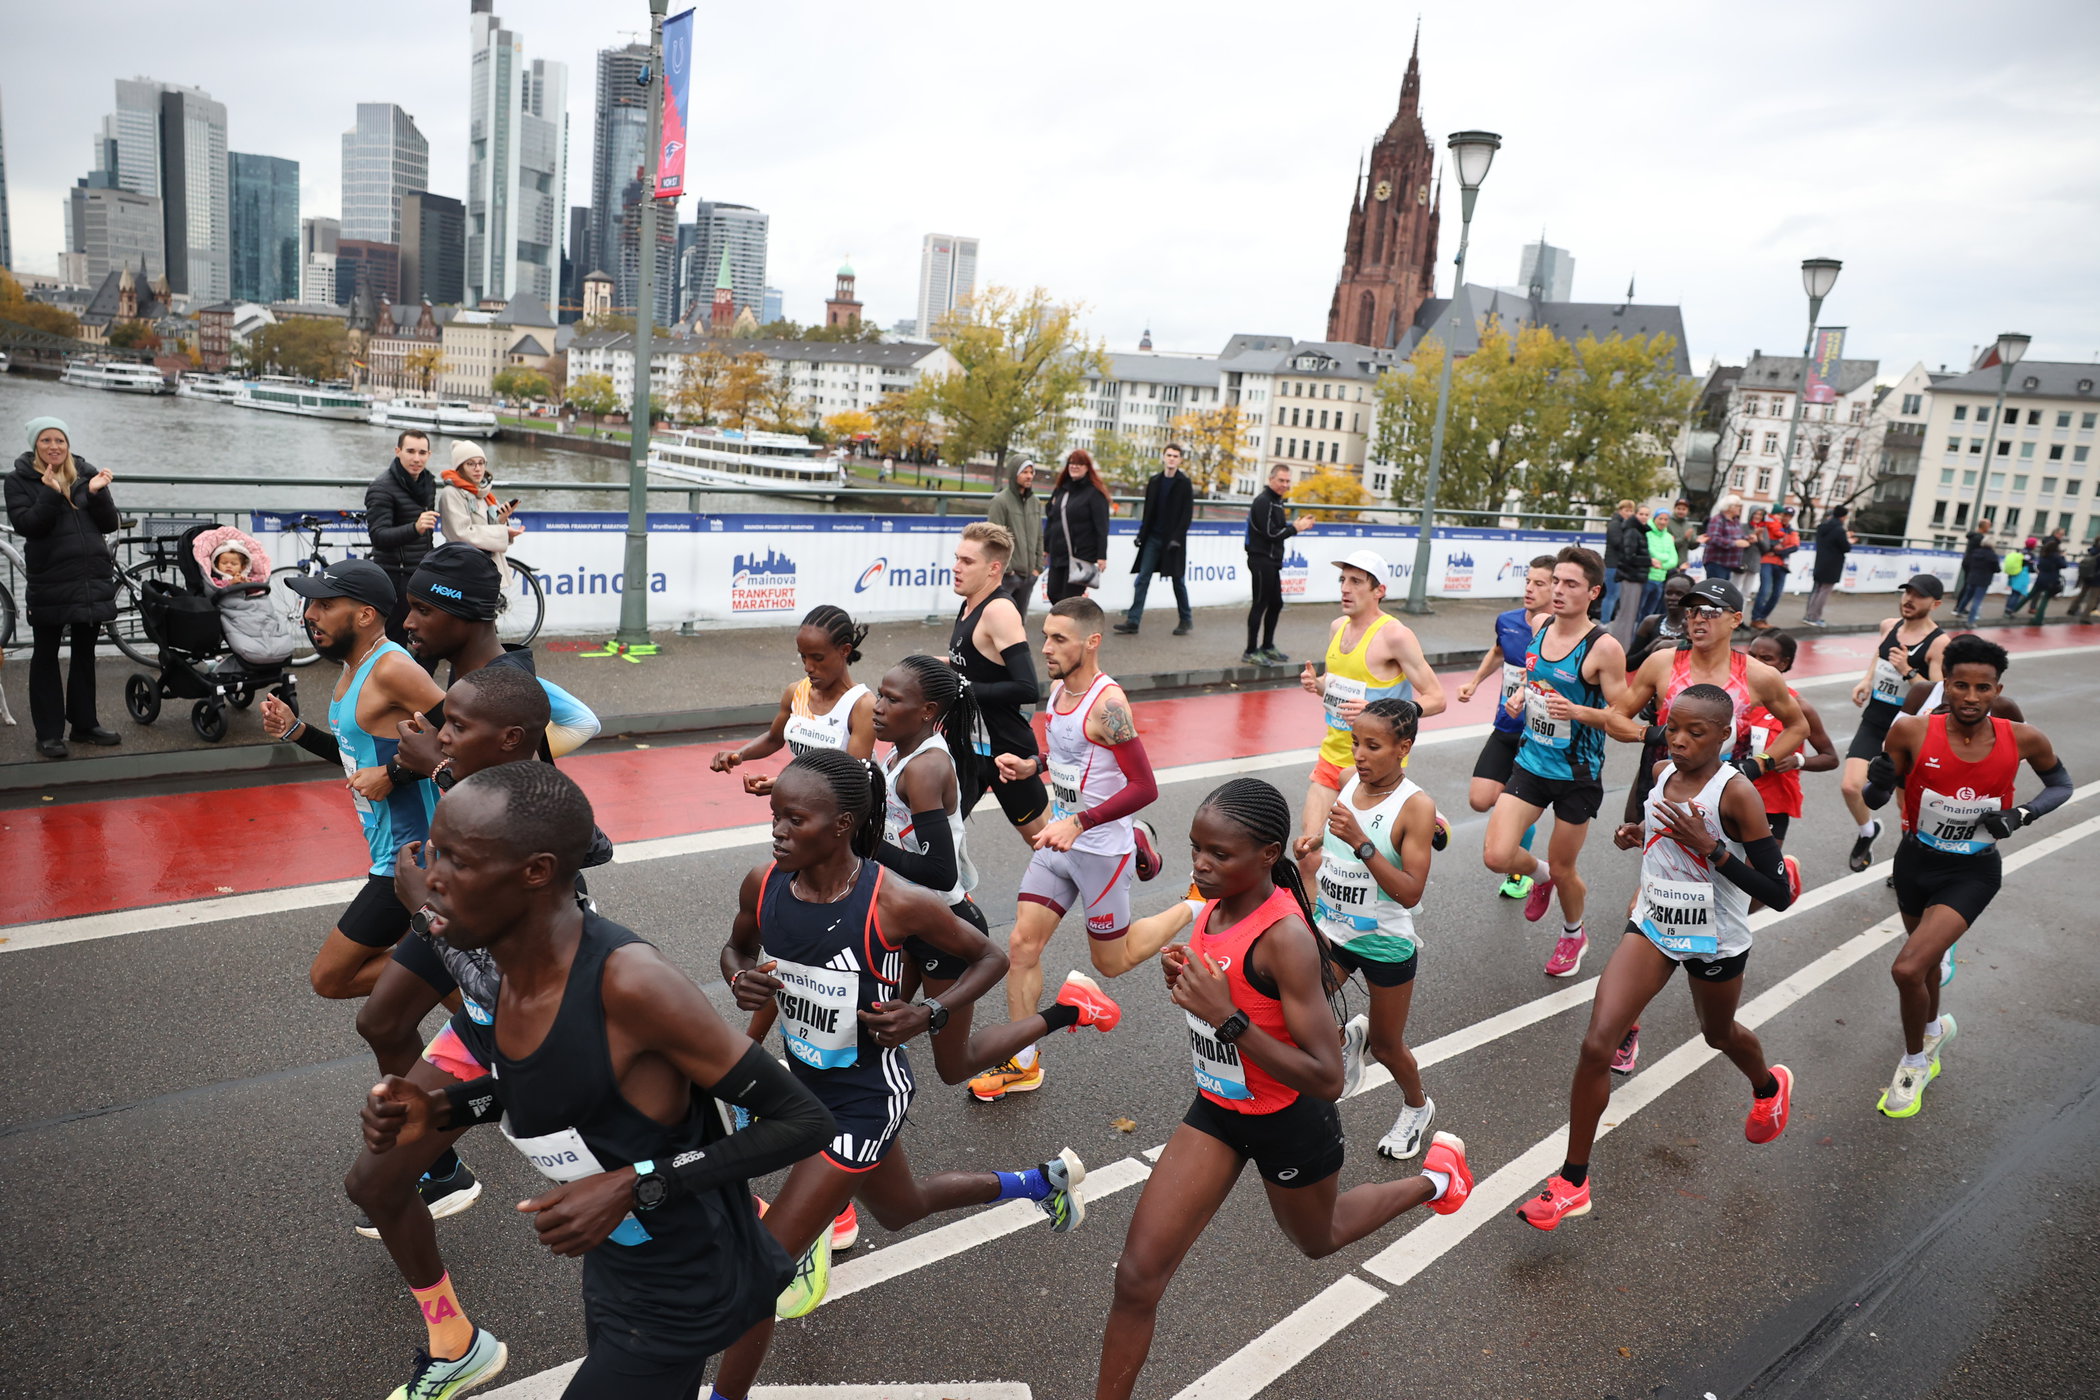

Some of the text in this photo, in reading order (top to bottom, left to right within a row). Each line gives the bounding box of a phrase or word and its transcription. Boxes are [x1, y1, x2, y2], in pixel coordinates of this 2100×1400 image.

[522, 566, 666, 596] mainoa
[747, 574, 796, 586] mainova
[430, 583, 462, 600] HOKA
[732, 588, 795, 599] FRANKFURT
[732, 599, 795, 610] MARATHON
[1877, 680, 1899, 695] 2781
[800, 727, 836, 744] mainova
[1531, 717, 1556, 737] 1590
[1932, 821, 1976, 841] 7038
[1934, 840, 1971, 853] HOKA
[1320, 875, 1368, 906] MESERET
[1653, 888, 1706, 902] mainova
[1089, 921, 1113, 930] MGC
[1667, 927, 1676, 936] F5
[781, 971, 847, 997] mainova
[799, 1026, 809, 1040] F2
[786, 1036, 825, 1067] HOKA
[1190, 1028, 1239, 1067] FRIDAH
[672, 1151, 706, 1168] adidas
